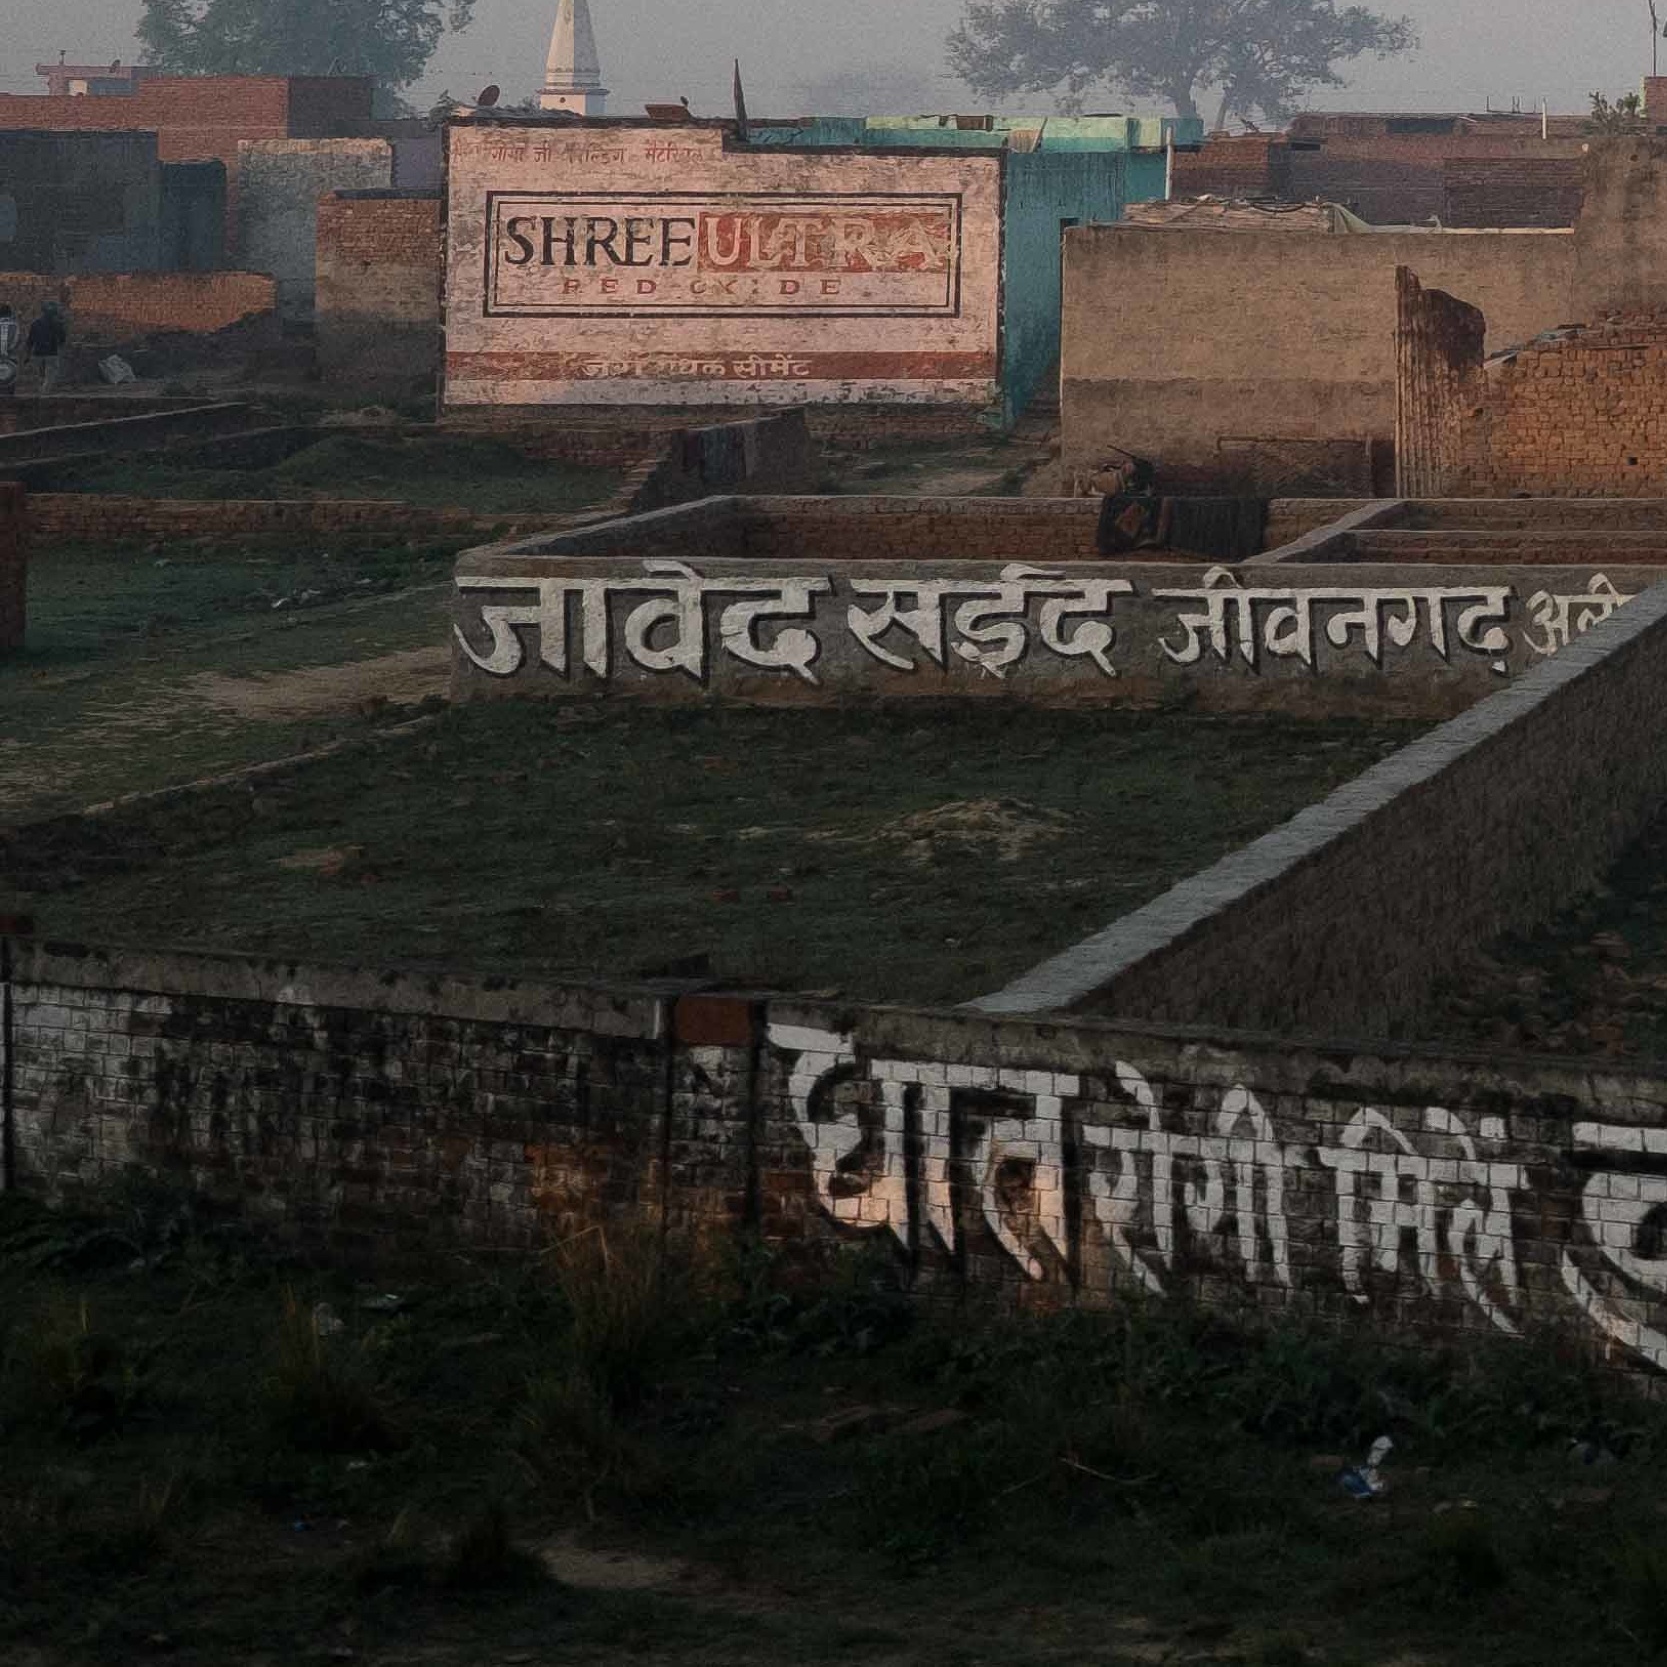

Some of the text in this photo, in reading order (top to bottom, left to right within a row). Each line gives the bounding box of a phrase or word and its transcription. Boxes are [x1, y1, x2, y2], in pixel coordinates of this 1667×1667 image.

[503, 213, 945, 272] SHREE ULTRA
[561, 278, 658, 295] RED
[732, 352, 813, 379] सीमेंट
[454, 559, 832, 685] जावेद
[847, 563, 1133, 677] सईद
